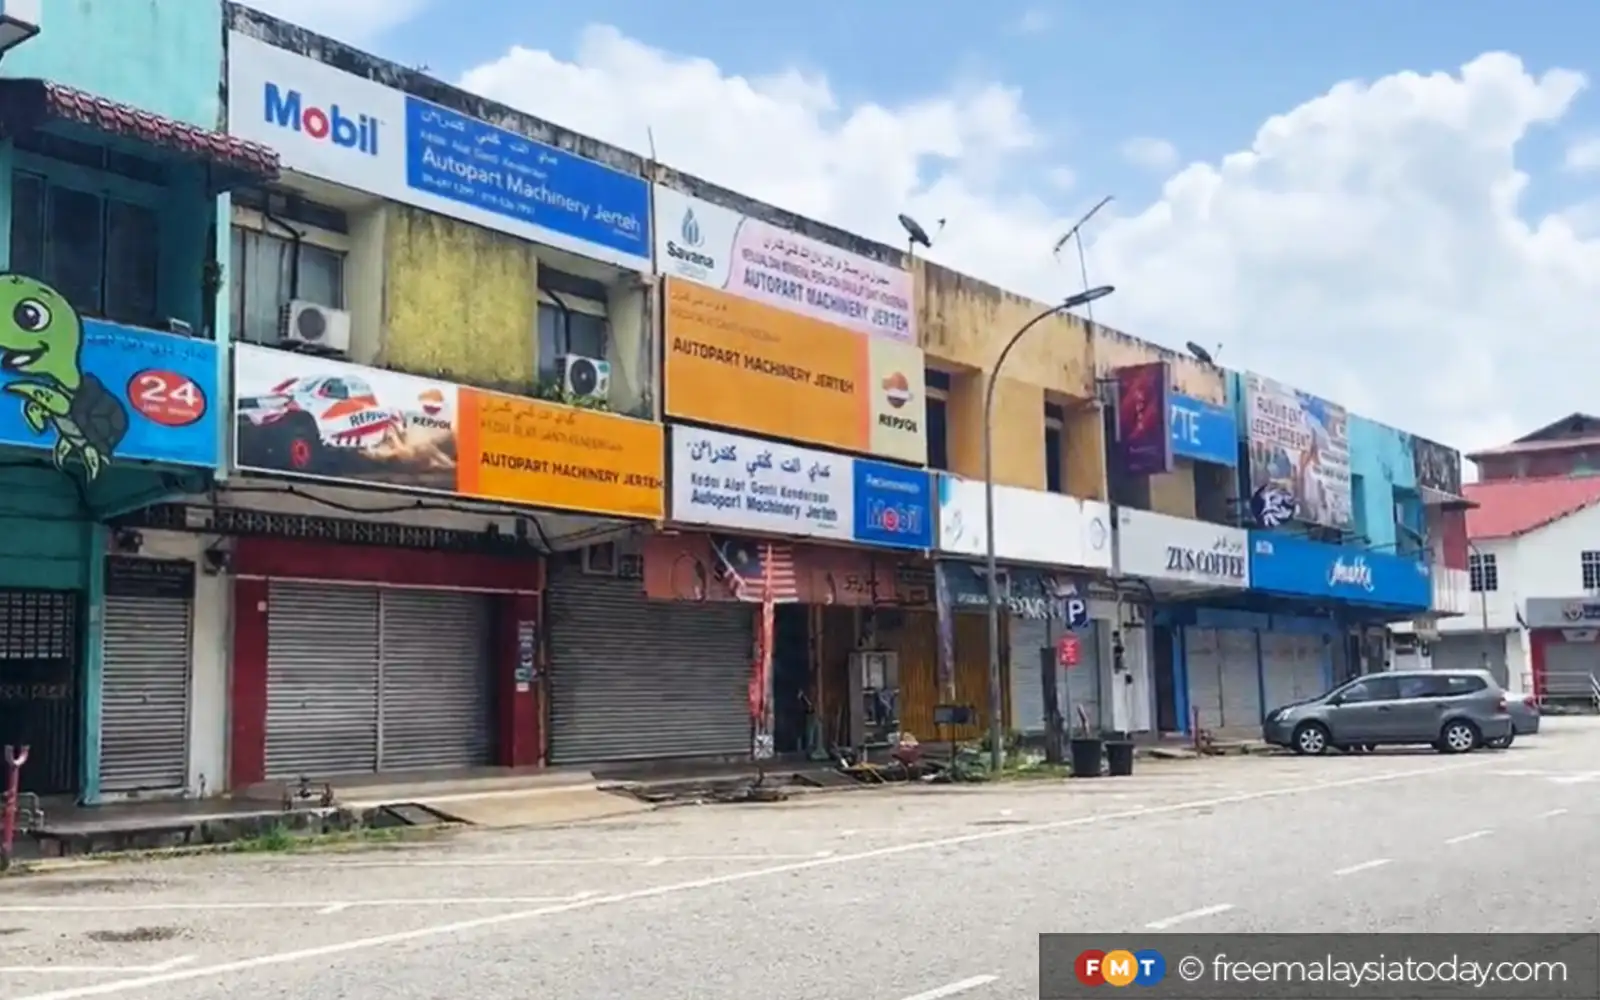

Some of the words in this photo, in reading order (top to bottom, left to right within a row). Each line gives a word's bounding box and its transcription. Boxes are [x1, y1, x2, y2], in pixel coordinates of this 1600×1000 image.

[264, 81, 378, 156] Mobil
[422, 145, 503, 189] Autopart
[506, 173, 590, 221] Machinery
[594, 204, 640, 232] Jerteh
[667, 240, 714, 269] Savana
[744, 267, 804, 302] AUTOPART
[806, 287, 868, 321] MACHINERY
[872, 308, 909, 333] JERTEH
[673, 337, 740, 367] AUTOPART
[744, 355, 811, 383] MACHINERY
[813, 373, 854, 394] JERTEH
[140, 375, 198, 407] 24
[878, 413, 918, 433] REPSOL
[481, 451, 548, 473] AUTOPART
[552, 463, 619, 485] MACHINERY
[690, 489, 741, 510] Autopart
[746, 495, 801, 520] Machinery
[805, 505, 838, 522] Jerteh
[866, 497, 923, 534] Mobil
[1196, 550, 1245, 579] COFFEE
[1068, 599, 1085, 624] P
